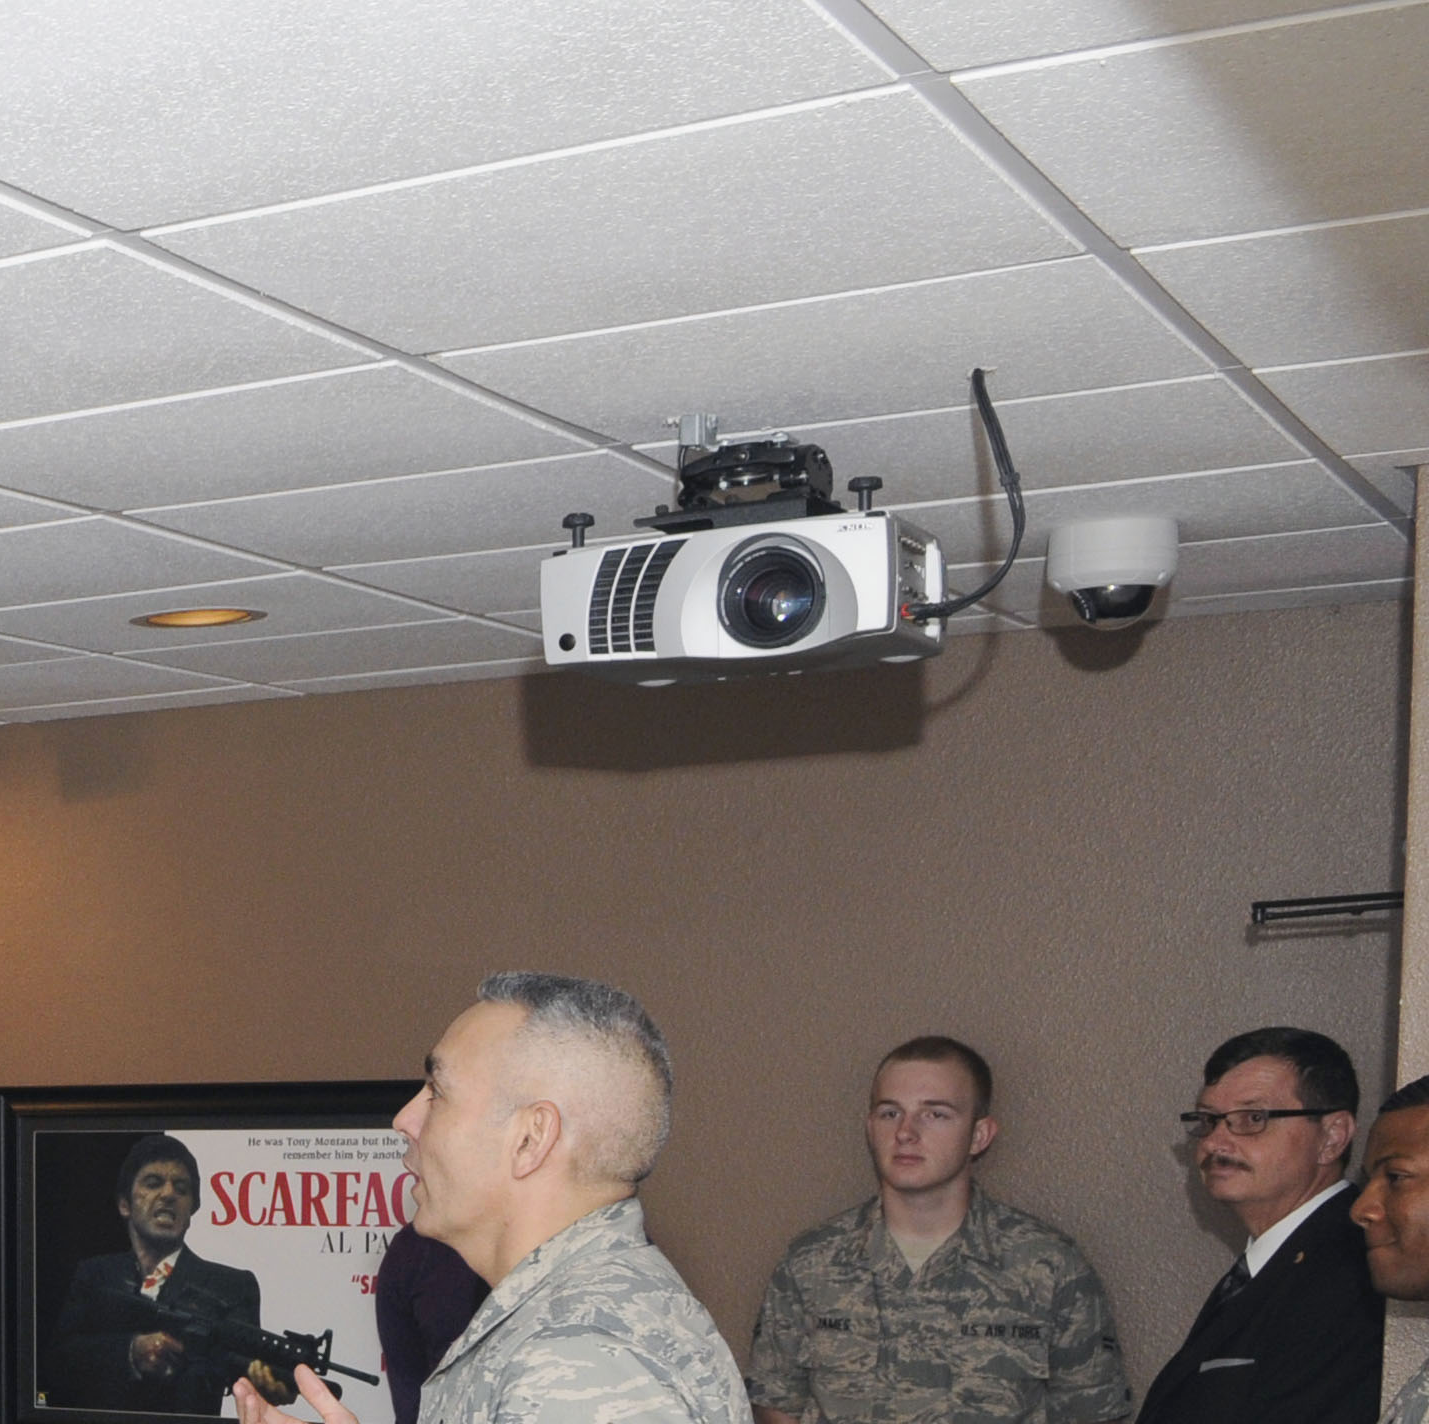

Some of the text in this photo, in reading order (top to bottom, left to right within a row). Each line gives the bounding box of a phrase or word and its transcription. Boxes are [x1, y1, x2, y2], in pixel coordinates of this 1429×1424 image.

[248, 1137, 261, 1146] He
[264, 1138, 283, 1146] was
[287, 1137, 310, 1148] Tony
[315, 1137, 359, 1146] Montana
[362, 1137, 379, 1146] but
[382, 1137, 399, 1146] the
[283, 1151, 331, 1160] remember
[335, 1150, 354, 1160] him
[357, 1151, 371, 1161] by
[210, 1171, 420, 1227] SCARFAC
[320, 1231, 352, 1253] AL
[817, 1318, 851, 1331] JAMES
